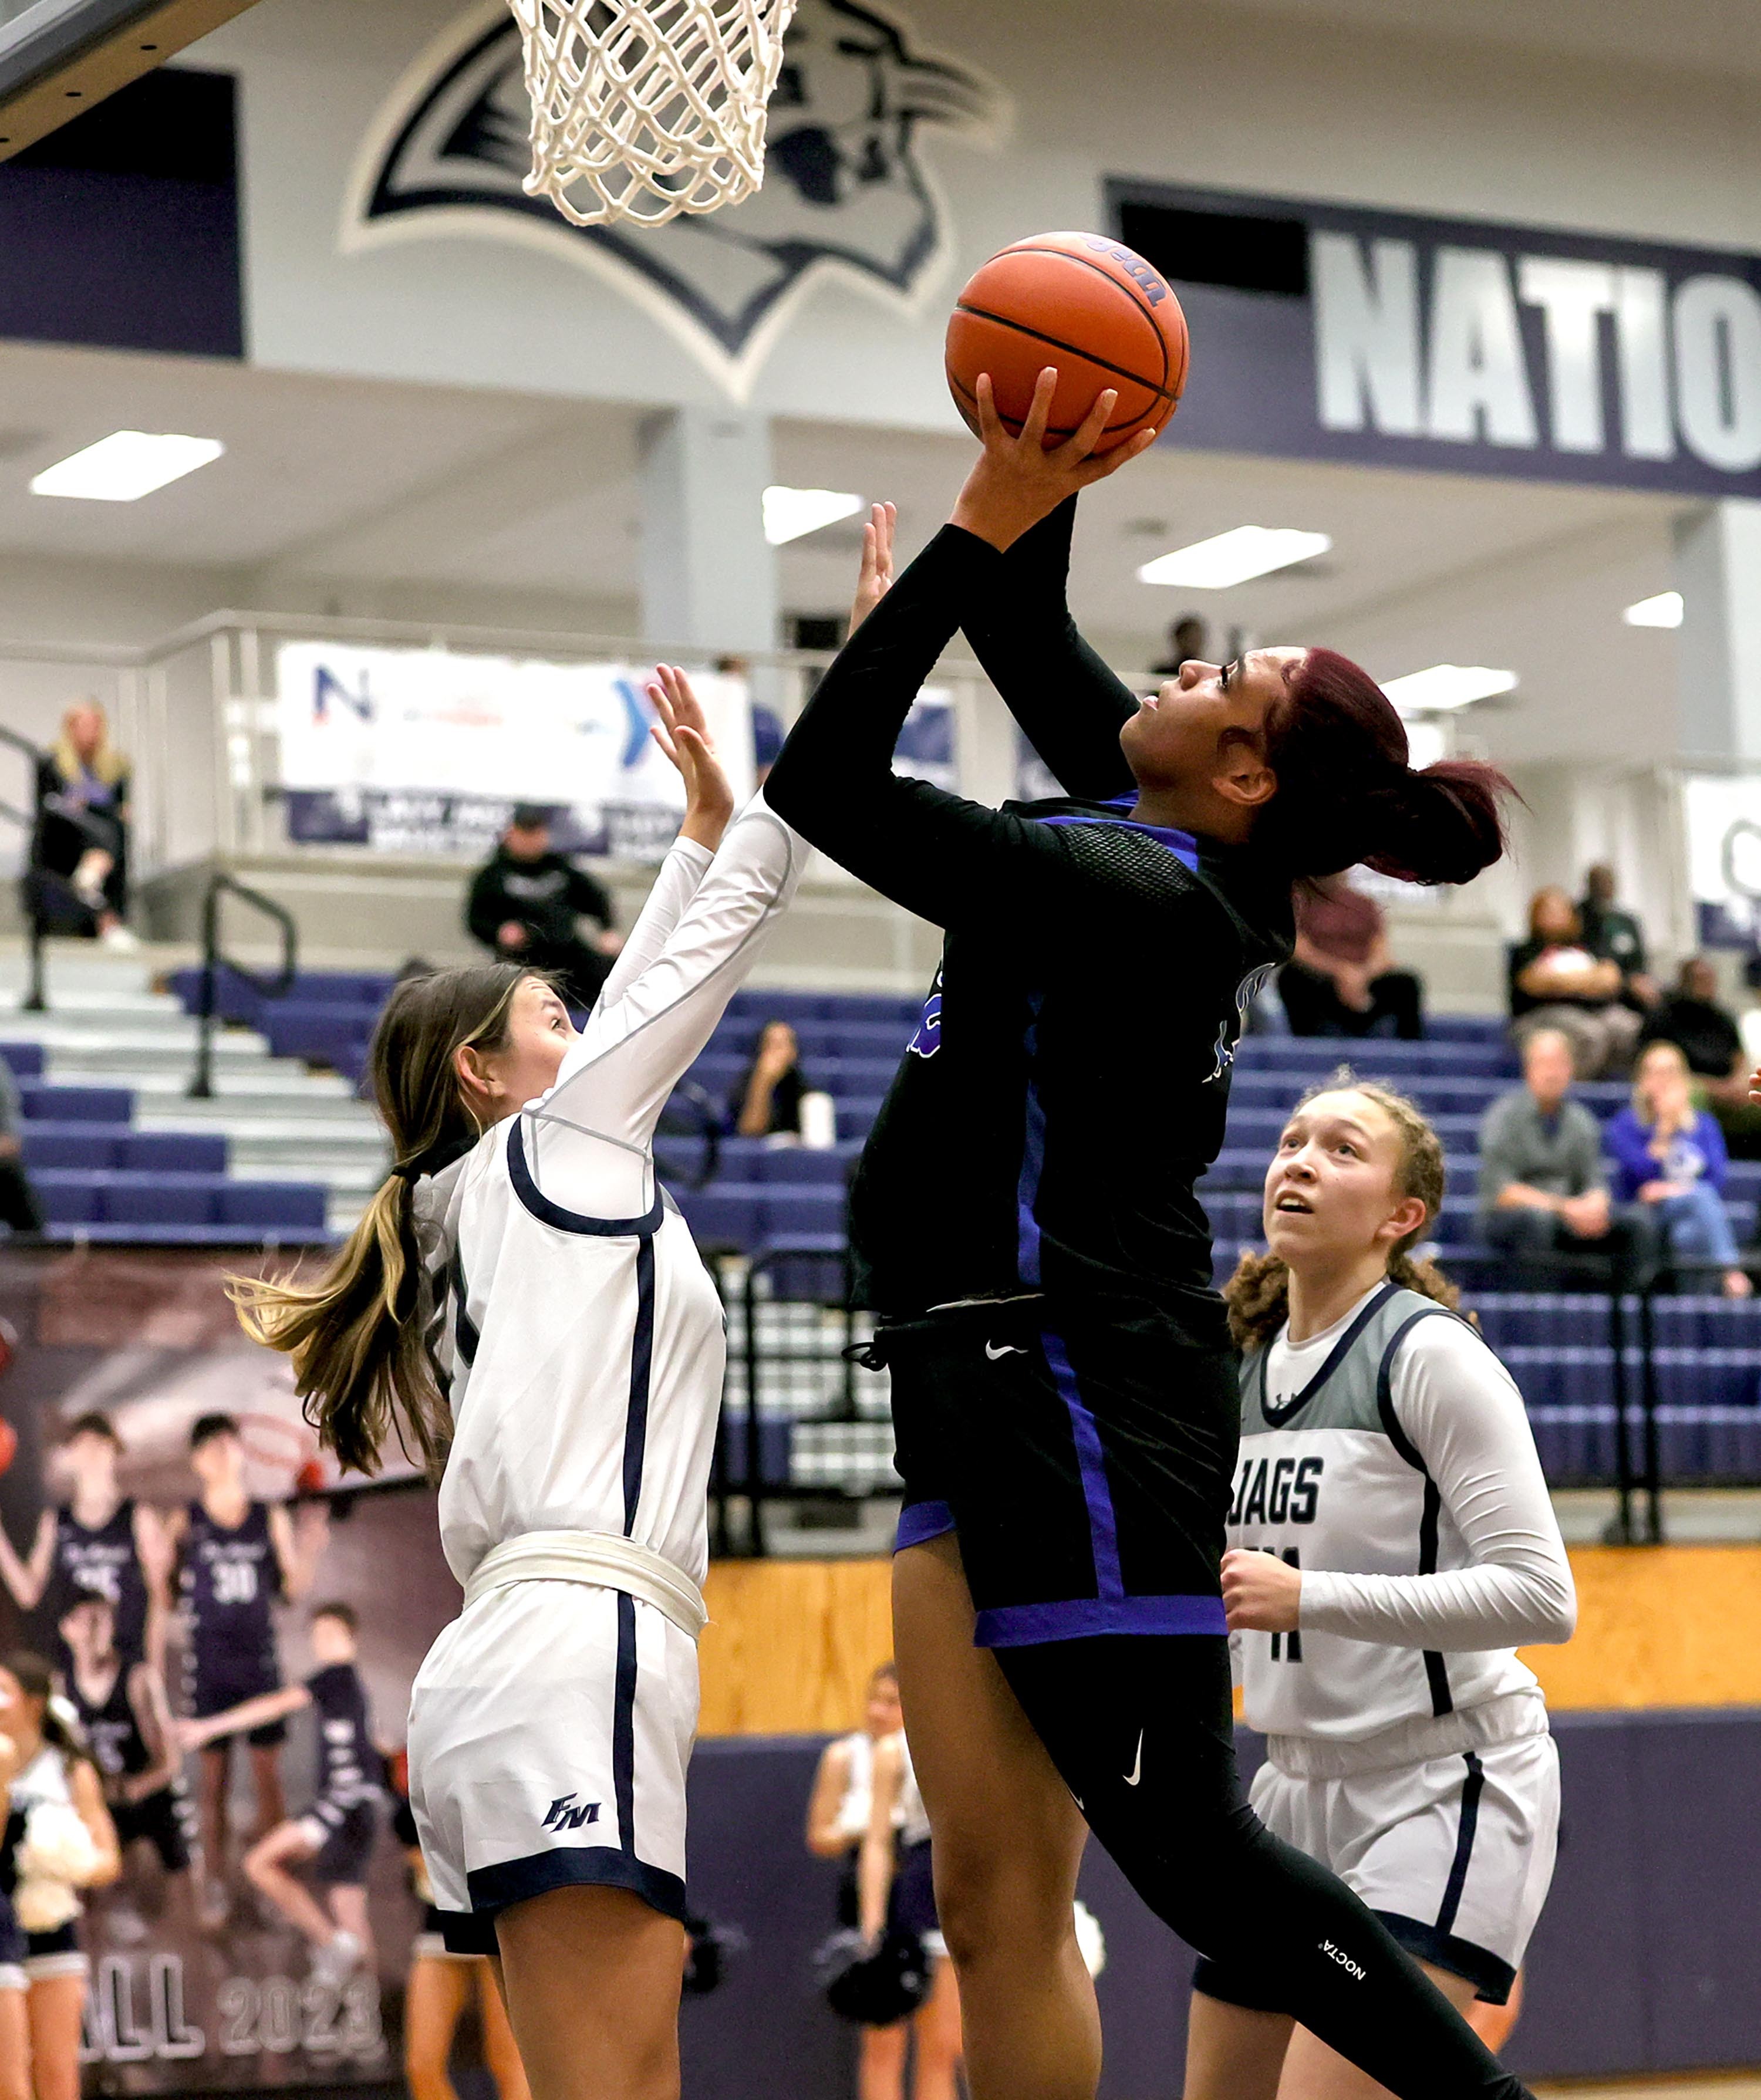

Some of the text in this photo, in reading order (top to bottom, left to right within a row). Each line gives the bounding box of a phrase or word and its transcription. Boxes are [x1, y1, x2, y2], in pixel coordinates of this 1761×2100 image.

[1311, 231, 1761, 472] NATIO
[1227, 1457, 1323, 1525] JAGS
[541, 1792, 601, 1833] FM
[1324, 1939, 1366, 1980] NOCTA
